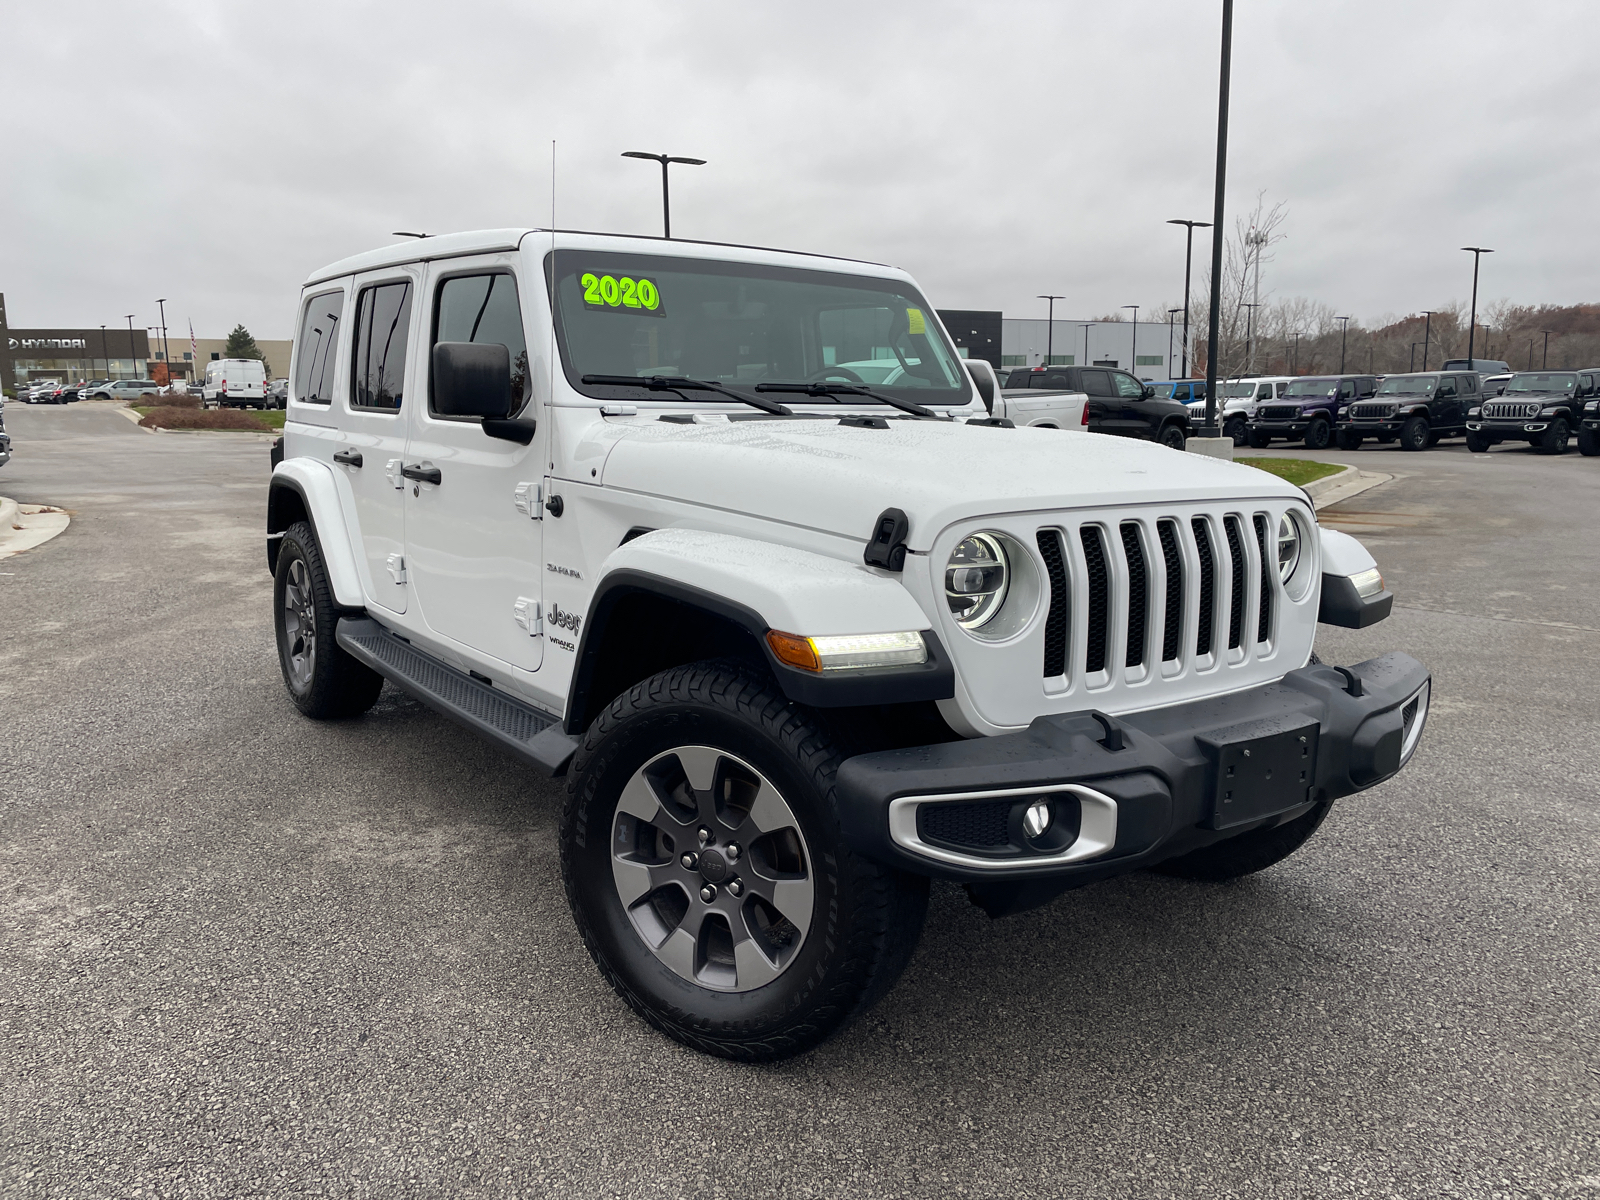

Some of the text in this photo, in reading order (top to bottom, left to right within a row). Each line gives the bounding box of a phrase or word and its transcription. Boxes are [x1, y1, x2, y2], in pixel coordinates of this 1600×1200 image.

[581, 272, 660, 311] 2020
[21, 338, 87, 349] HYUNDAI
[547, 602, 582, 637] Jeep
